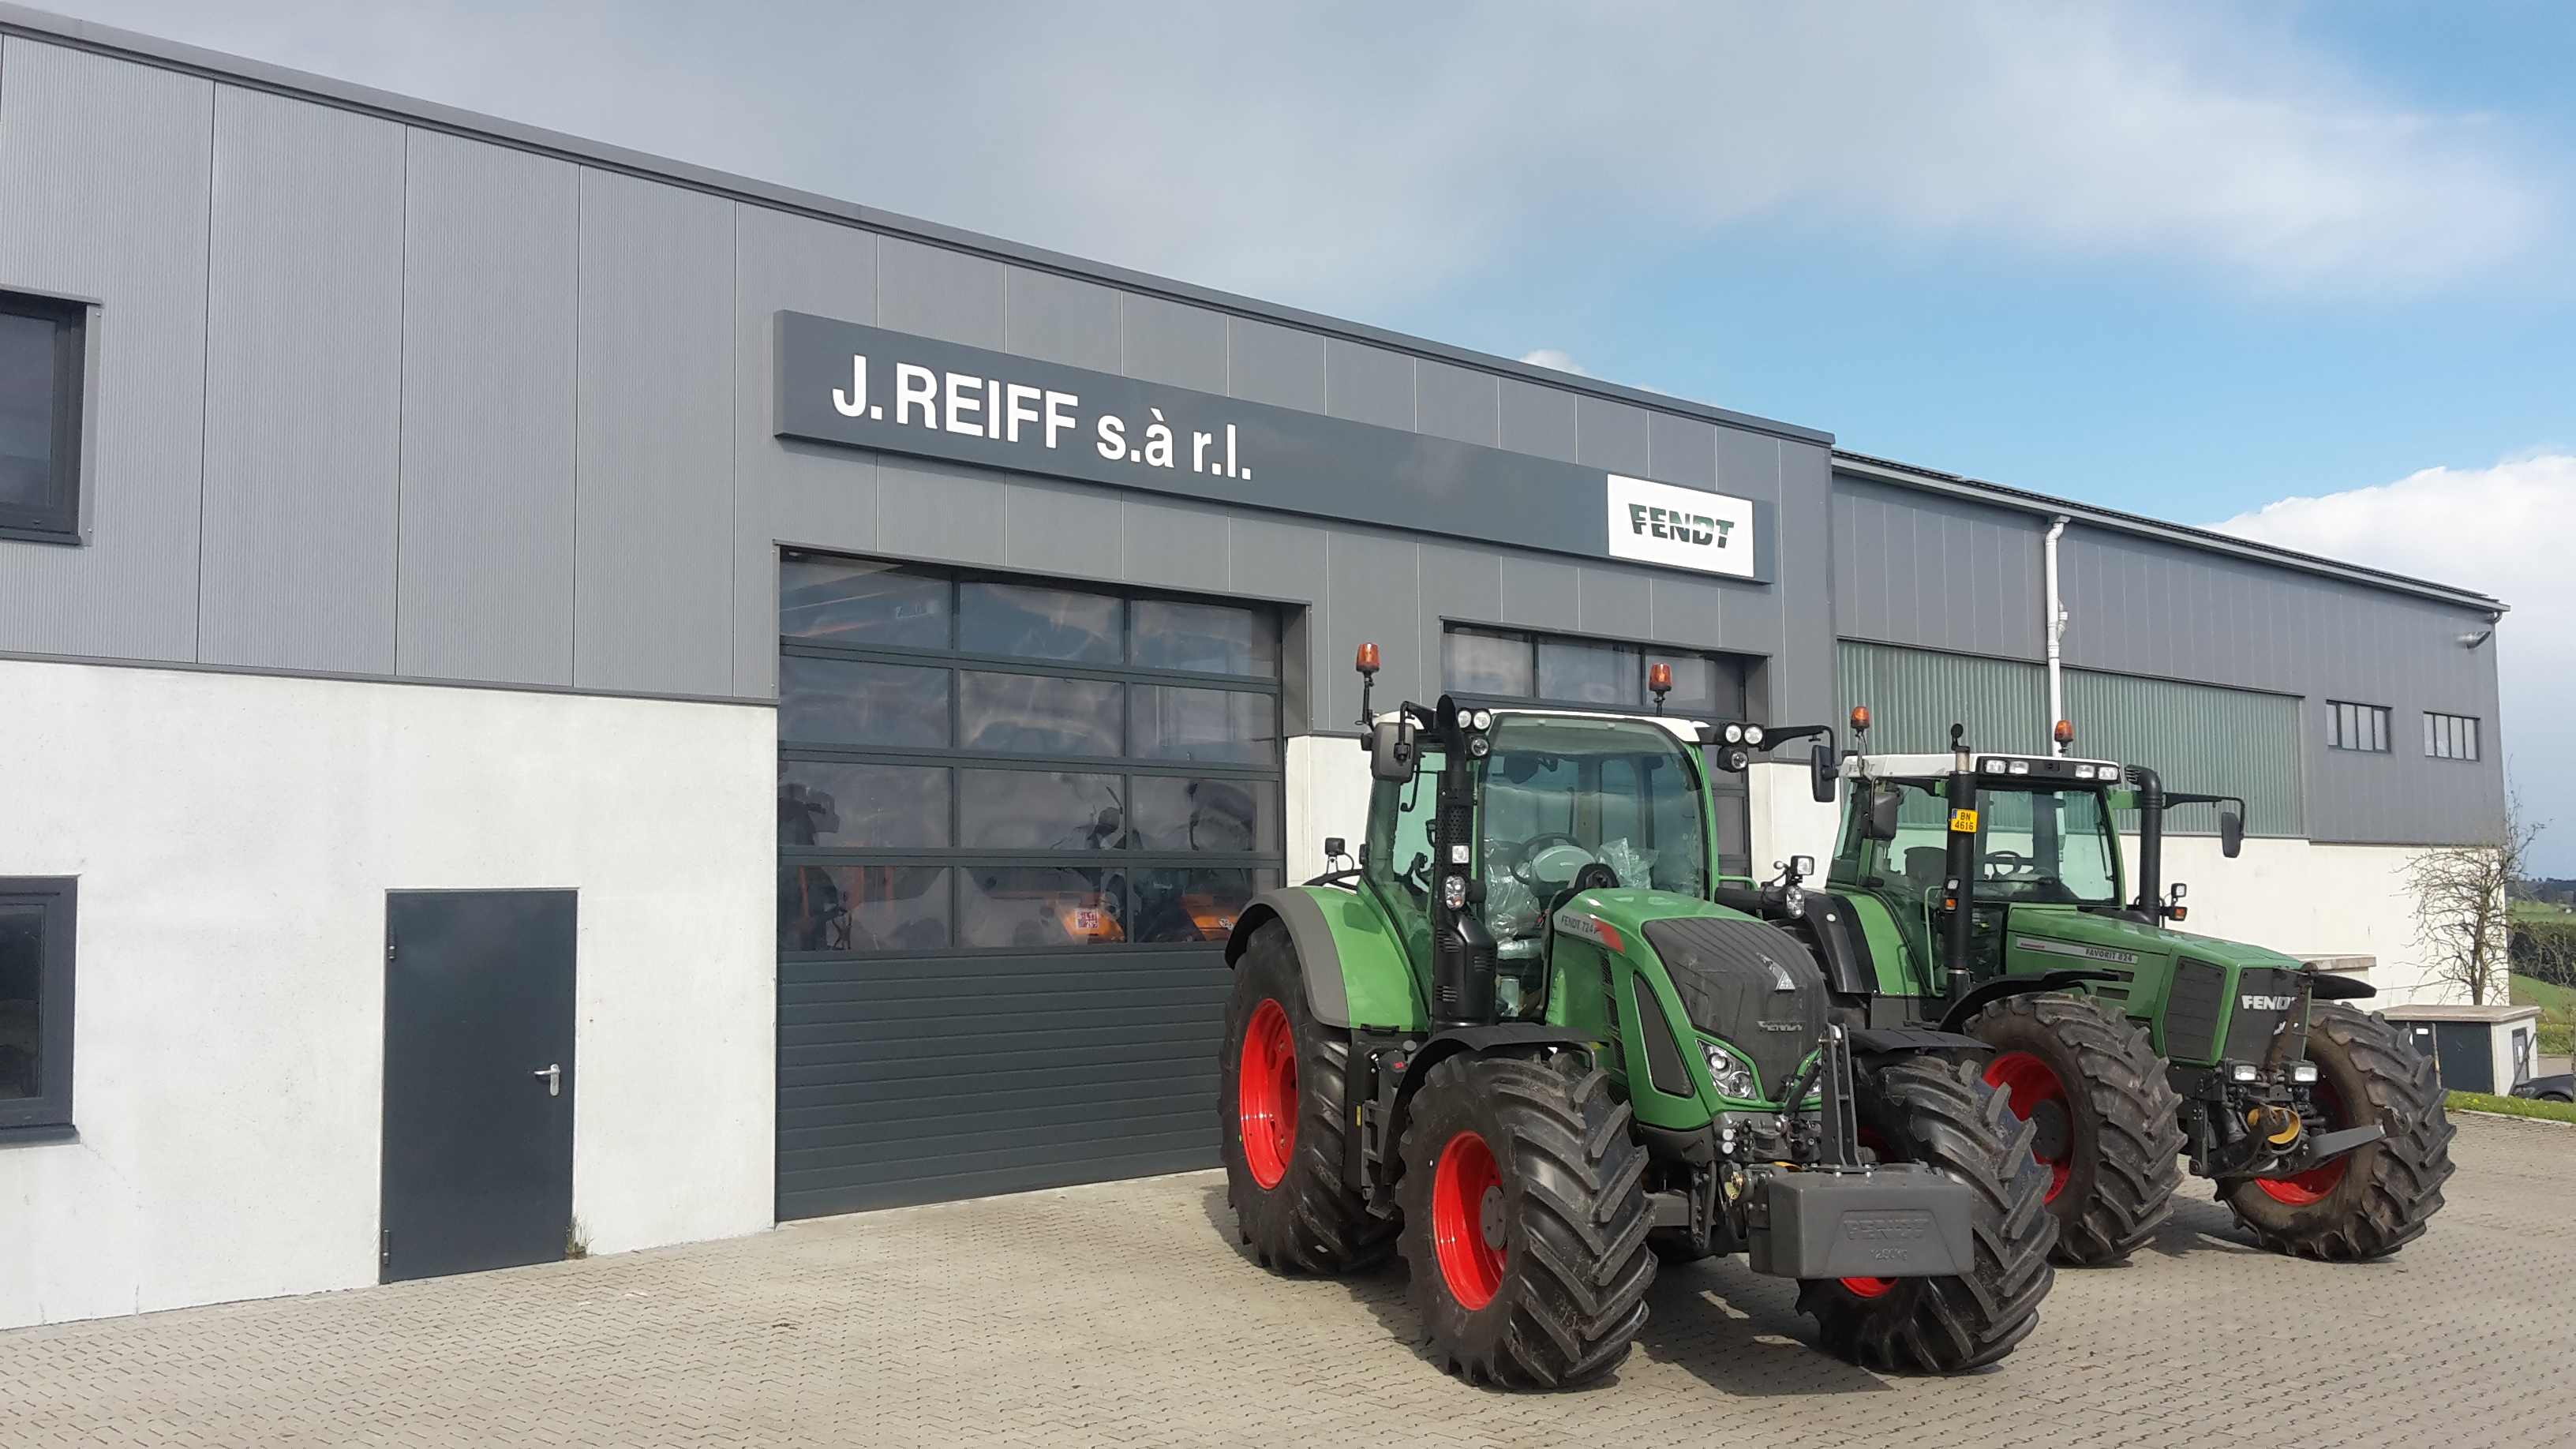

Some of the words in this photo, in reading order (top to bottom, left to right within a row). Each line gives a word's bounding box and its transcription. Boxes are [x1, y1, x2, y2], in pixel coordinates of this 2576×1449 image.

[1096, 407, 1174, 468] s.à
[1193, 424, 1252, 481] r.l.
[1628, 503, 1735, 549] FENDT
[1960, 811, 1971, 822] BN
[1954, 820, 1974, 830] 4616
[1561, 915, 1582, 930] FENDT
[1582, 920, 1594, 933] 724
[2085, 947, 2116, 960] FAVORIT
[2117, 952, 2132, 962] 824
[1754, 1020, 1807, 1032] FENDT
[1844, 1218, 1930, 1241] FENDT
